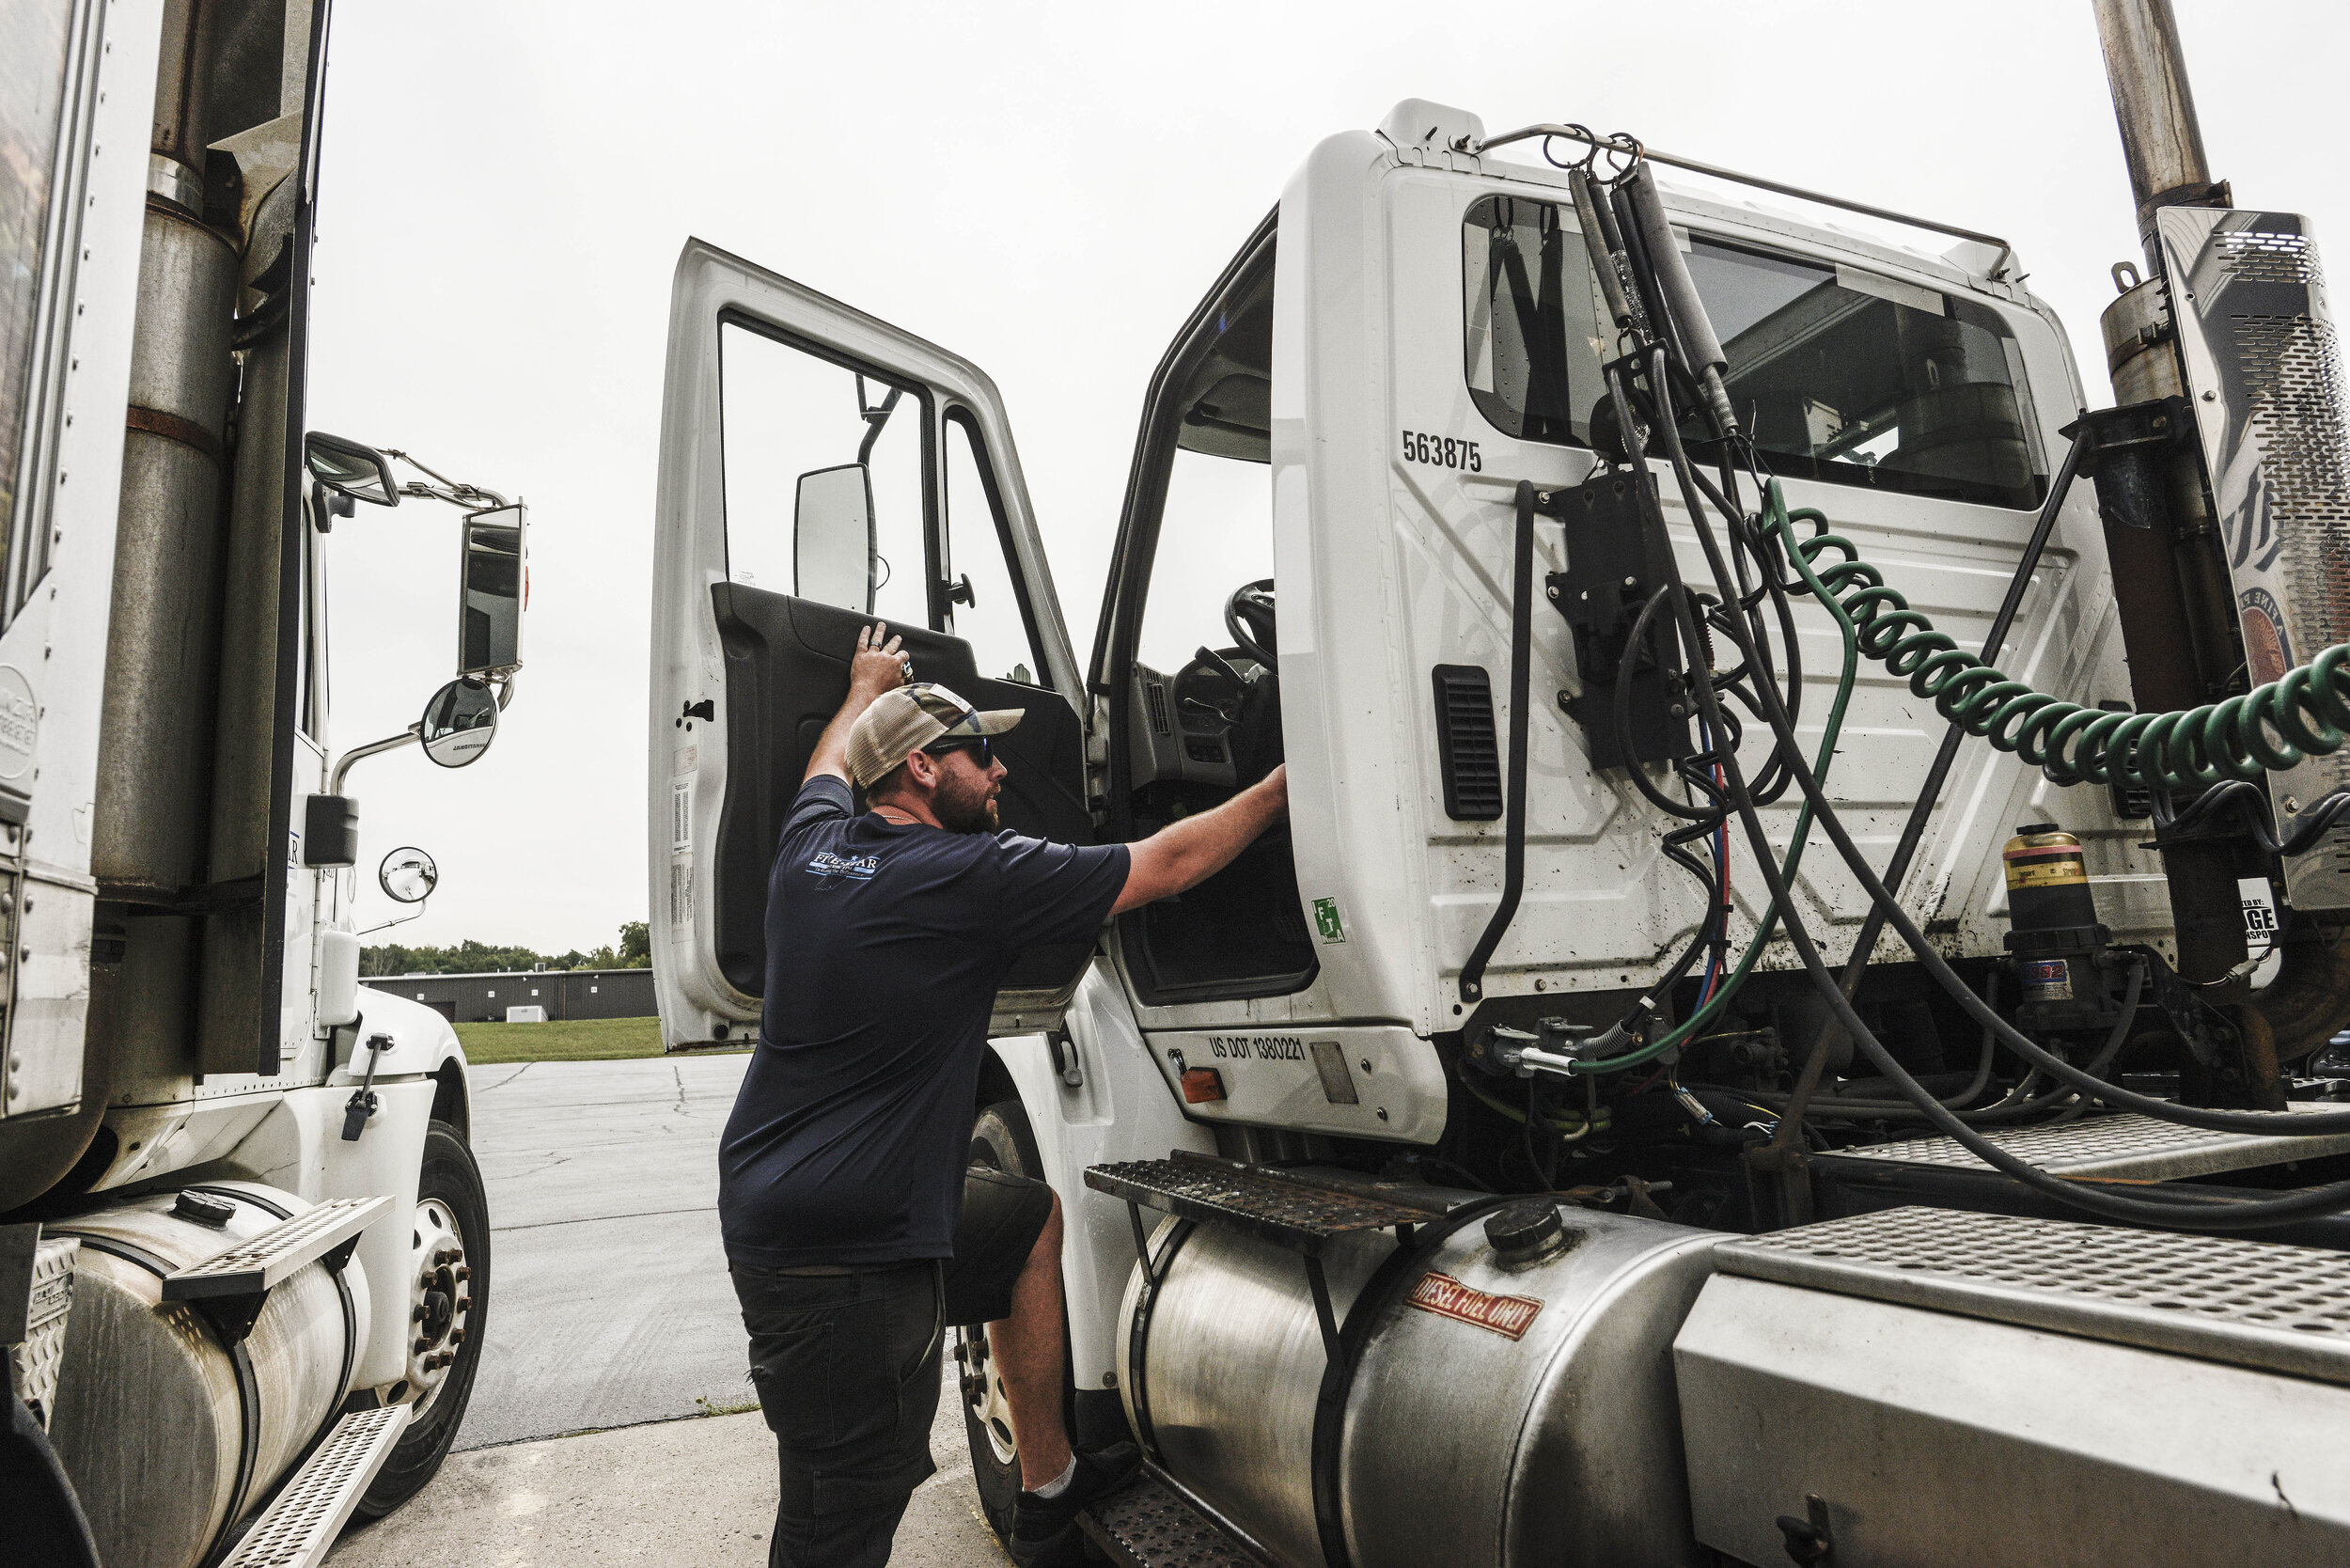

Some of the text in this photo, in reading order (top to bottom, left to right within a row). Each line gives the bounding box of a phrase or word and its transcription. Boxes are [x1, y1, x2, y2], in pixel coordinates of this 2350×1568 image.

[1402, 430, 1482, 473] 563875
[2252, 898, 2264, 906] BY:
[2247, 908, 2275, 931] GE
[1209, 1037, 1306, 1060] US DOT 1380221
[1415, 1277, 1536, 1331] DIESEL FUEL ONLY
